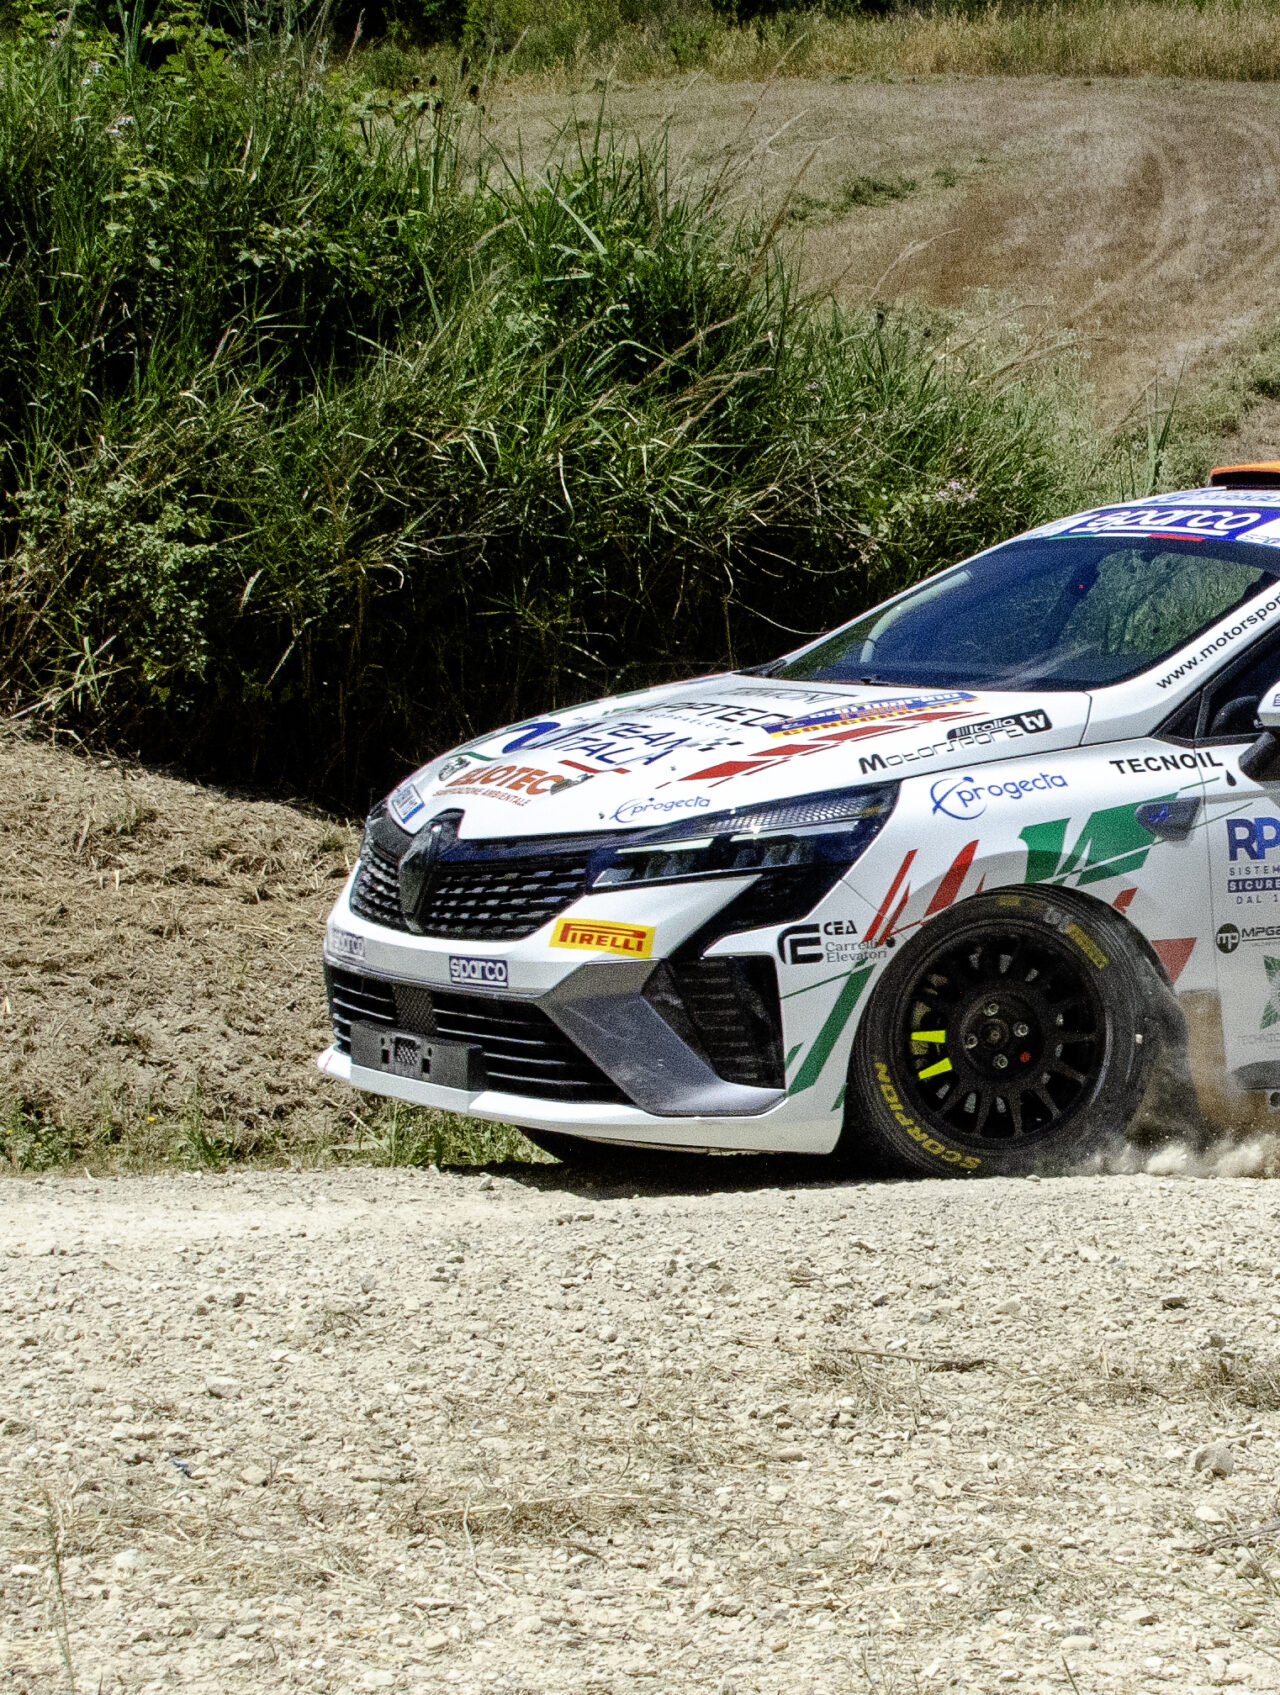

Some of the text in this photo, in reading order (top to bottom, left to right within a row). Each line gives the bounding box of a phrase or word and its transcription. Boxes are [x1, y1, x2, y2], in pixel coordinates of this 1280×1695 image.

[1086, 508, 1262, 532] sparco
[1020, 714, 1047, 731] tv
[1110, 751, 1223, 775] TECNOIL
[957, 772, 1068, 807] progecta
[631, 796, 711, 816] progecta
[1236, 895, 1262, 904] DAL
[559, 922, 646, 953] PIRELLI
[823, 920, 858, 936] CEA
[825, 939, 878, 953] Carrelli
[826, 947, 888, 963] Elevatori
[451, 957, 507, 983] sparco
